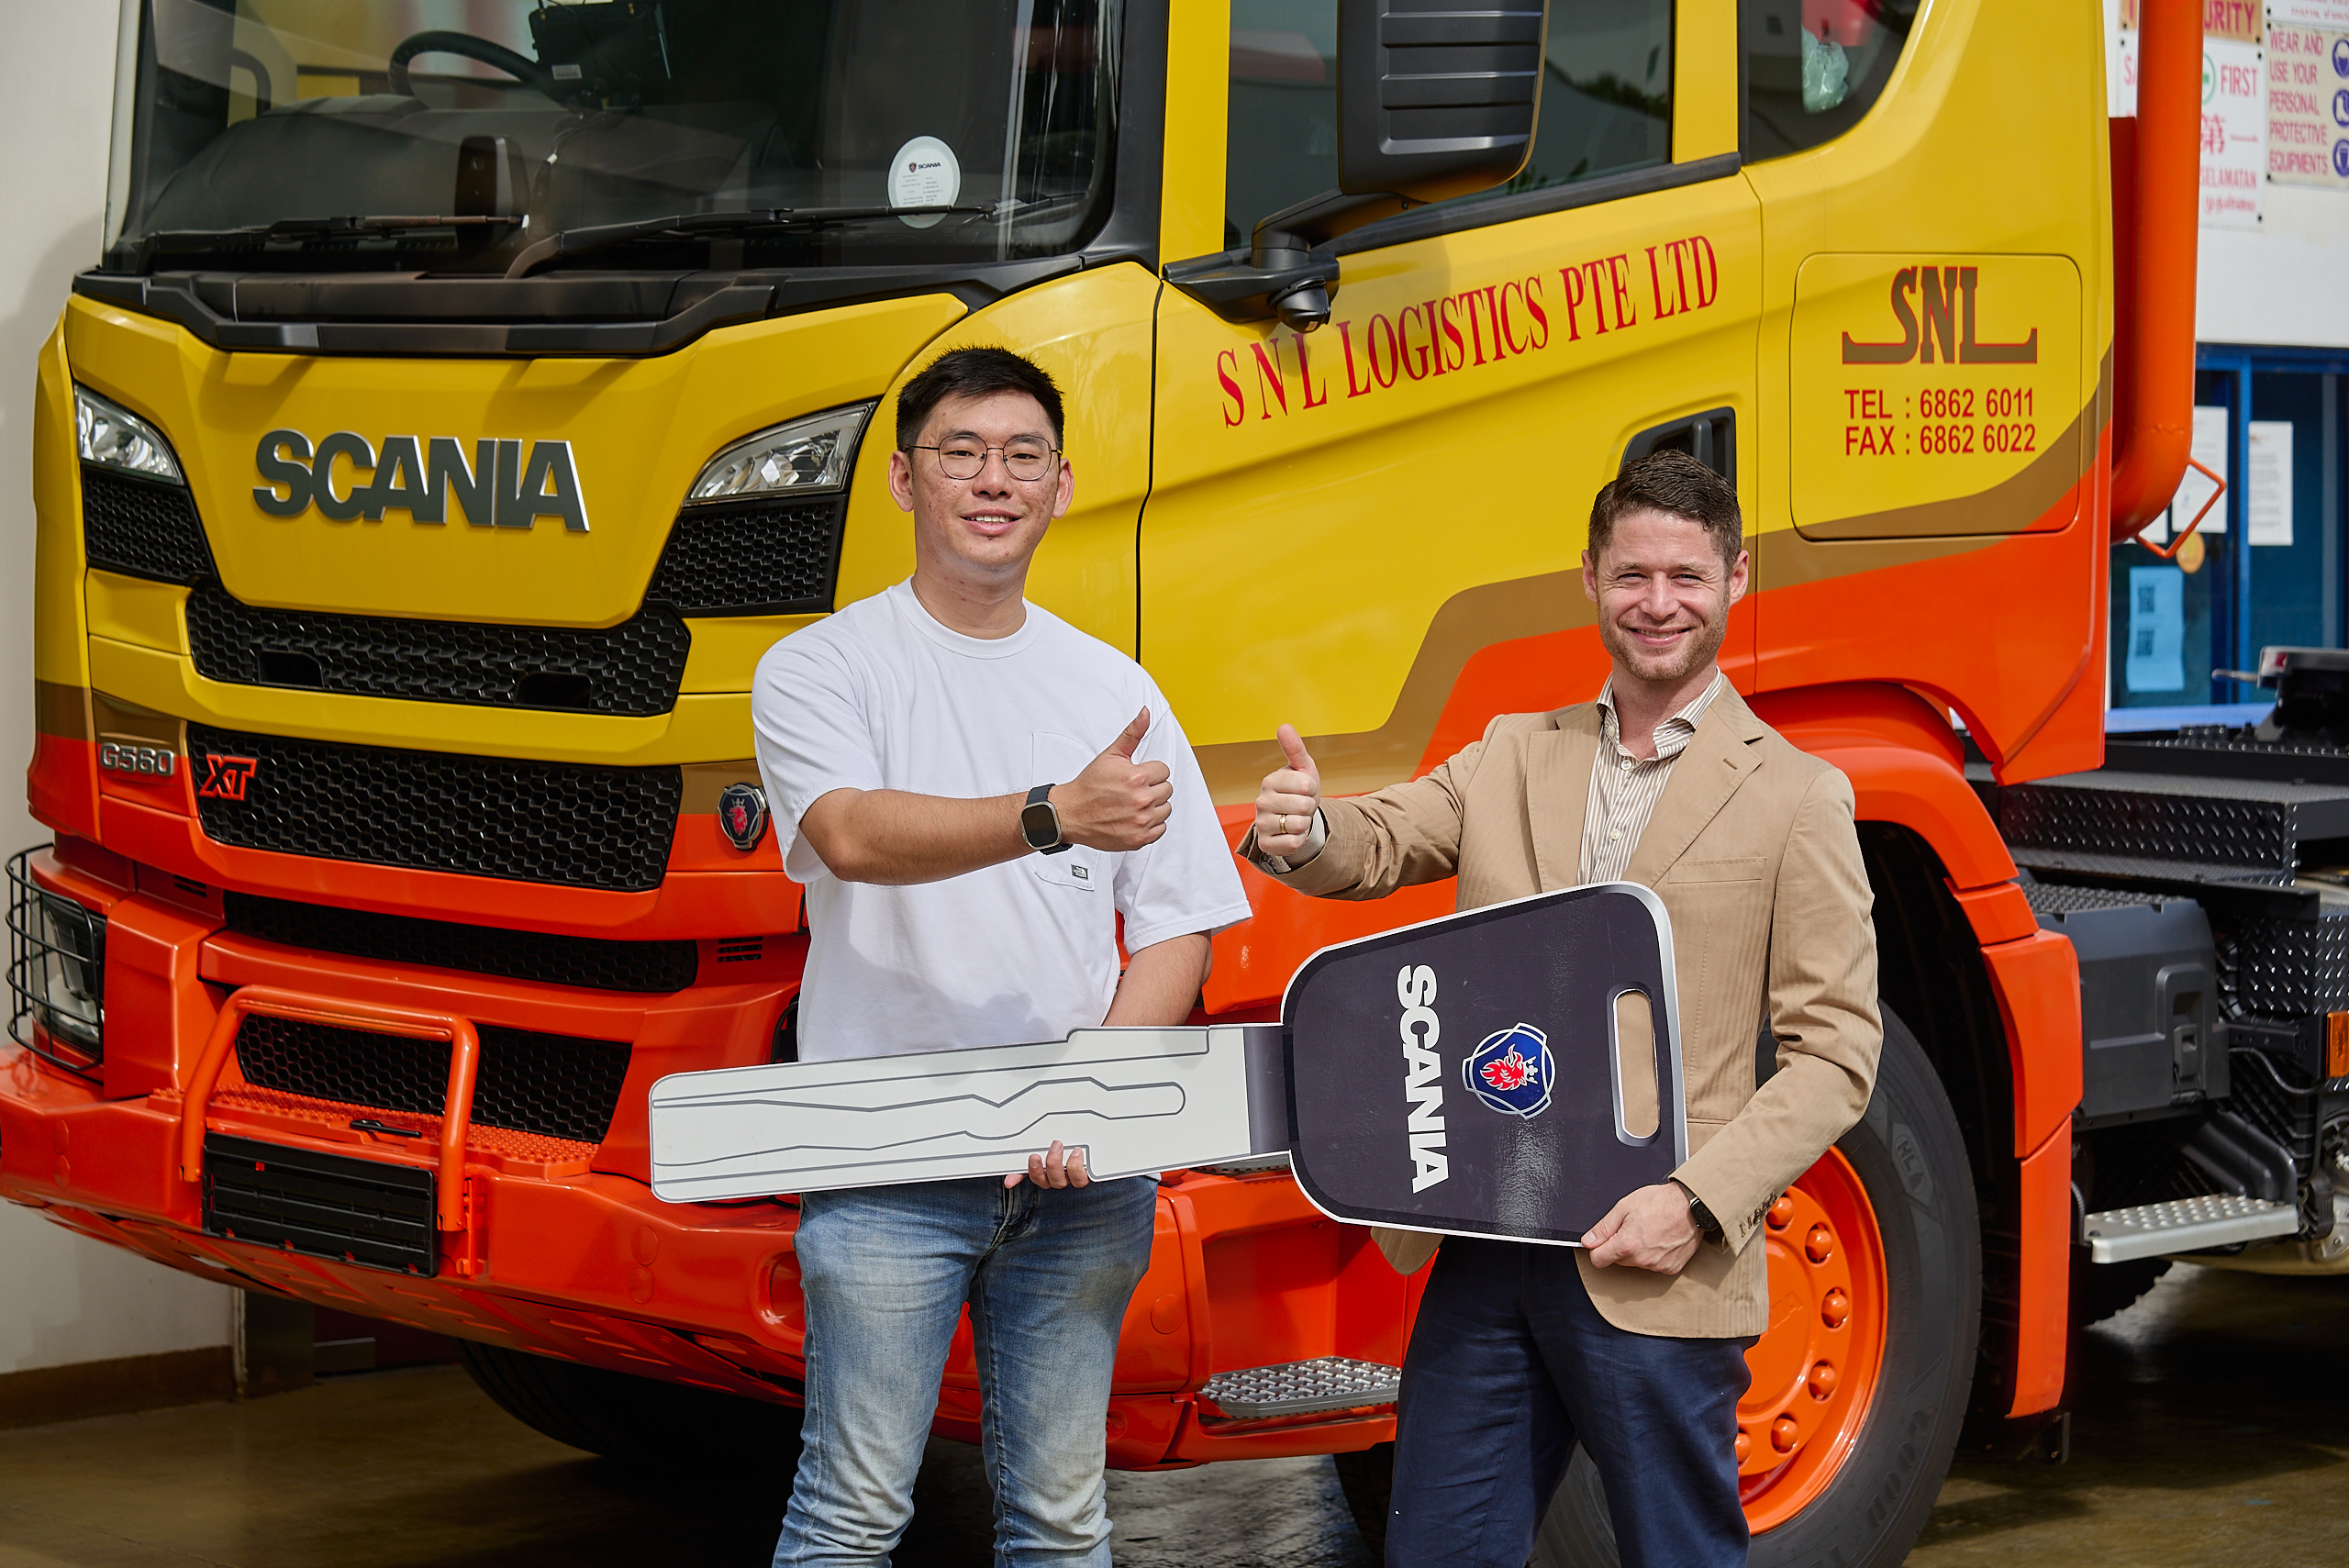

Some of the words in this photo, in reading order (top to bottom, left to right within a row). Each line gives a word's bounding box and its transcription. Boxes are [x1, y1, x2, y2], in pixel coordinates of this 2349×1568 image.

[2203, 0, 2255, 34] URITY
[2269, 28, 2299, 53] WEAR
[2303, 33, 2324, 56] AND
[2221, 63, 2258, 97] FIRST
[2269, 60, 2288, 83] USE
[2292, 61, 2318, 85] YOUR
[2269, 88, 2320, 116] PERSONAL
[2200, 112, 2259, 155] 第一
[2269, 119, 2328, 146] PROTECTIVE
[918, 161, 941, 170] SCANIA
[2200, 166, 2257, 189] SELAMATAN
[2269, 149, 2328, 175] EQUIPMENTS
[1842, 265, 2038, 364] SNL
[1217, 349, 1244, 428] S
[1250, 338, 1287, 420] N
[1291, 332, 1327, 410] L
[1336, 274, 1549, 398] LOGISTICS
[1559, 253, 1637, 342] PTE
[1644, 236, 1718, 320] LTD
[1844, 389, 1893, 419] TEL
[1920, 388, 1975, 418] 6862
[1986, 387, 2033, 418] 6011
[1845, 425, 1896, 456] FAX
[1920, 425, 1975, 454] 6862
[1983, 423, 2036, 453] 6022
[252, 428, 590, 532] SCANIA
[100, 742, 175, 777] G560
[199, 753, 258, 801] XT
[1397, 964, 1449, 1194] SCANIA
